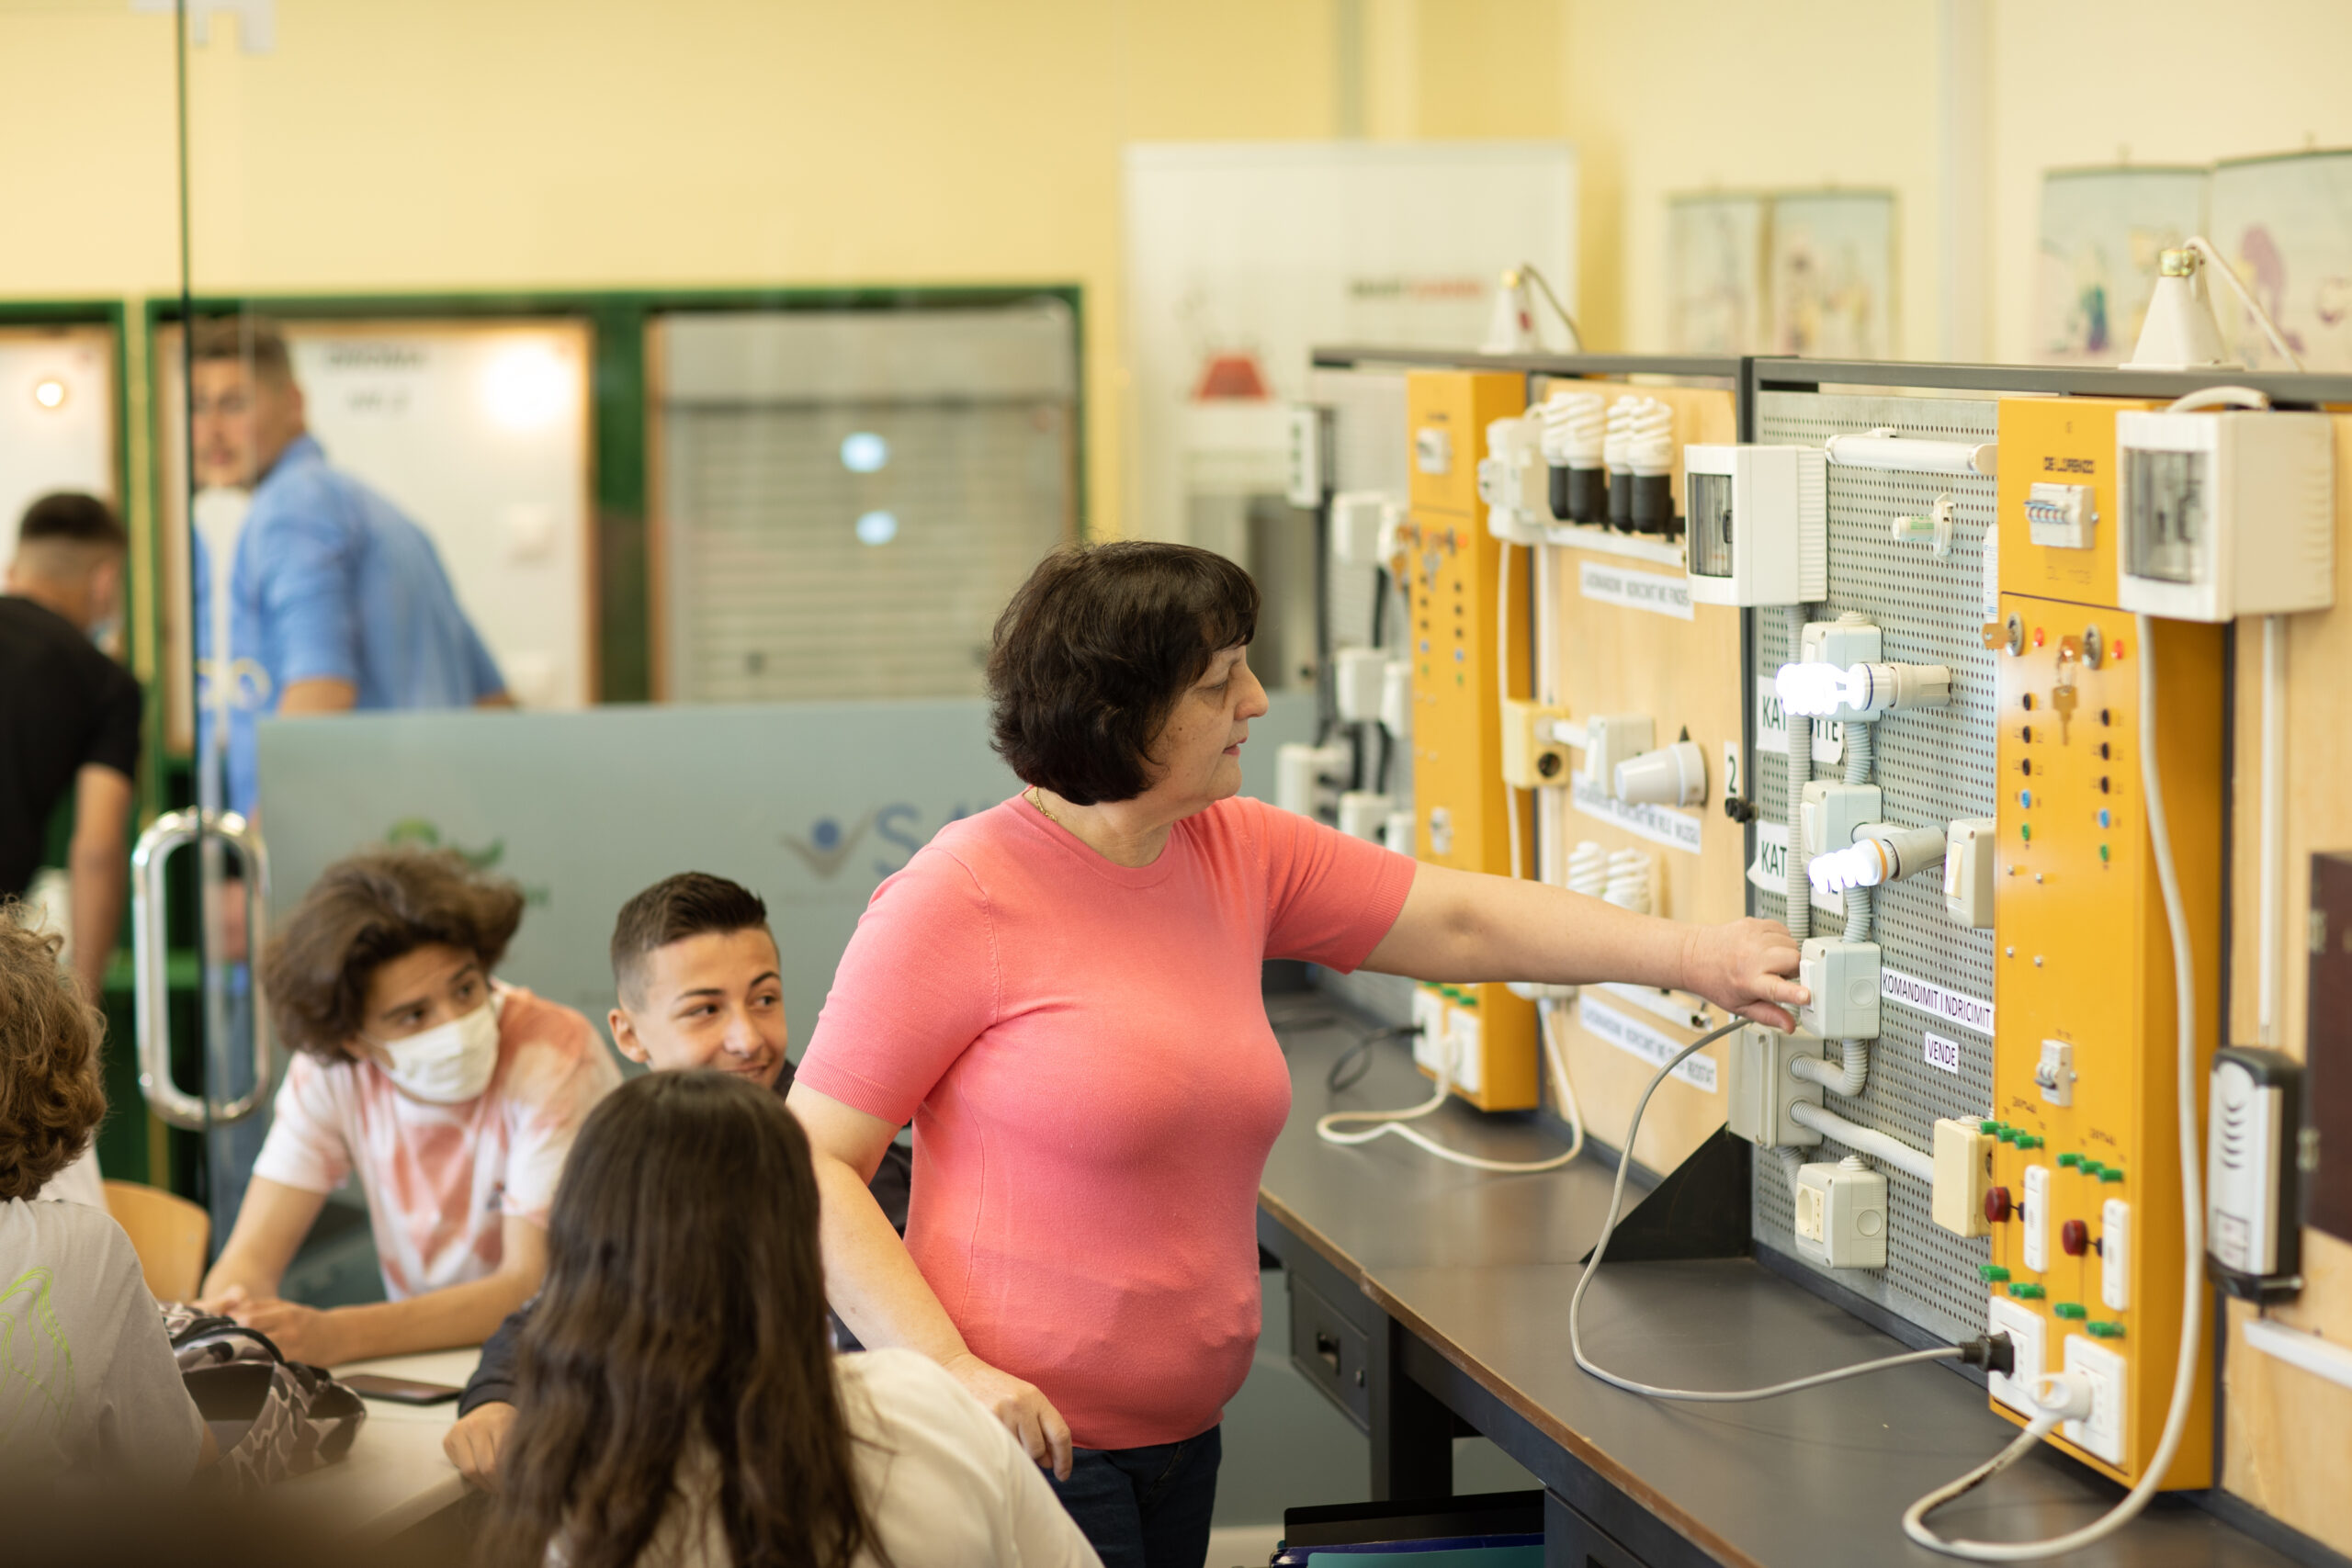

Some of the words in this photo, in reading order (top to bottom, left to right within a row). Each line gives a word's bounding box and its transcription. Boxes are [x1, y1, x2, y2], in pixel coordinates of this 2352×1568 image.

[1727, 754, 1737, 795] 2
[1883, 973, 1939, 1010] KOMANDIMIT
[1945, 994, 1991, 1029] NDRICIMIT
[1927, 1038, 1956, 1067] VENDE
